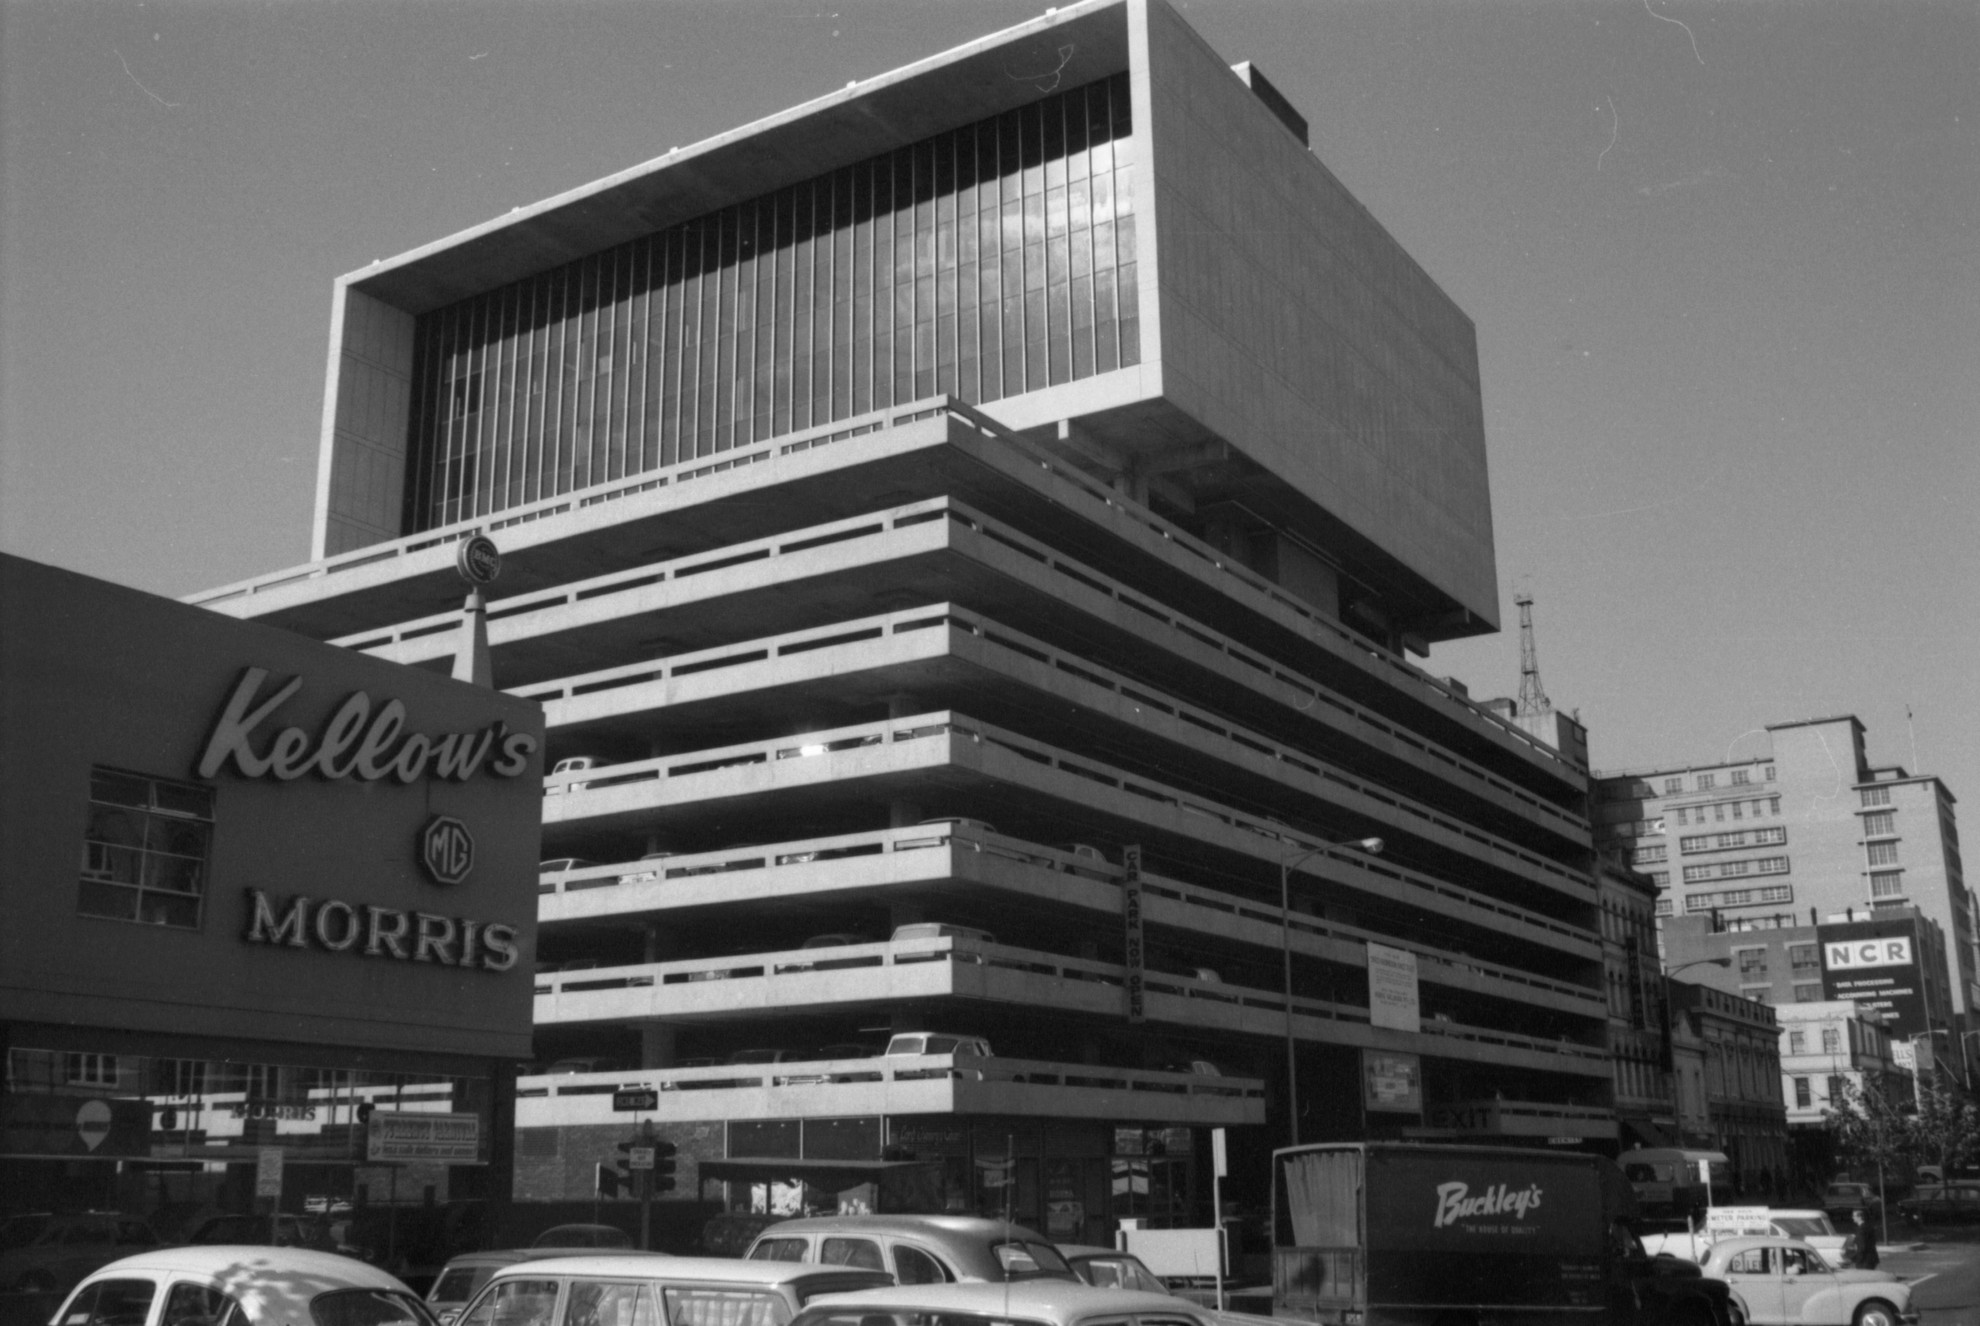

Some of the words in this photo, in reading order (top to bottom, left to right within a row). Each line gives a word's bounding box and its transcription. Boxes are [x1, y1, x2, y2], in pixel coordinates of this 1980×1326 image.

[199, 666, 537, 784] Kellow's
[431, 825, 471, 876] MG
[1126, 850, 1138, 882] CAR
[1127, 889, 1139, 929] PARK
[247, 889, 520, 971] MORRIS
[1128, 938, 1140, 968] NOW
[1832, 943, 1904, 964] NCR
[1130, 975, 1142, 1017] OPEN
[1837, 991, 1877, 1000] ACCOUNTING
[1879, 988, 1913, 996] MACHINES
[1854, 978, 1894, 987] PROCESSING
[230, 1103, 318, 1122] MORRIS
[1434, 1181, 1543, 1228] Buckley's
